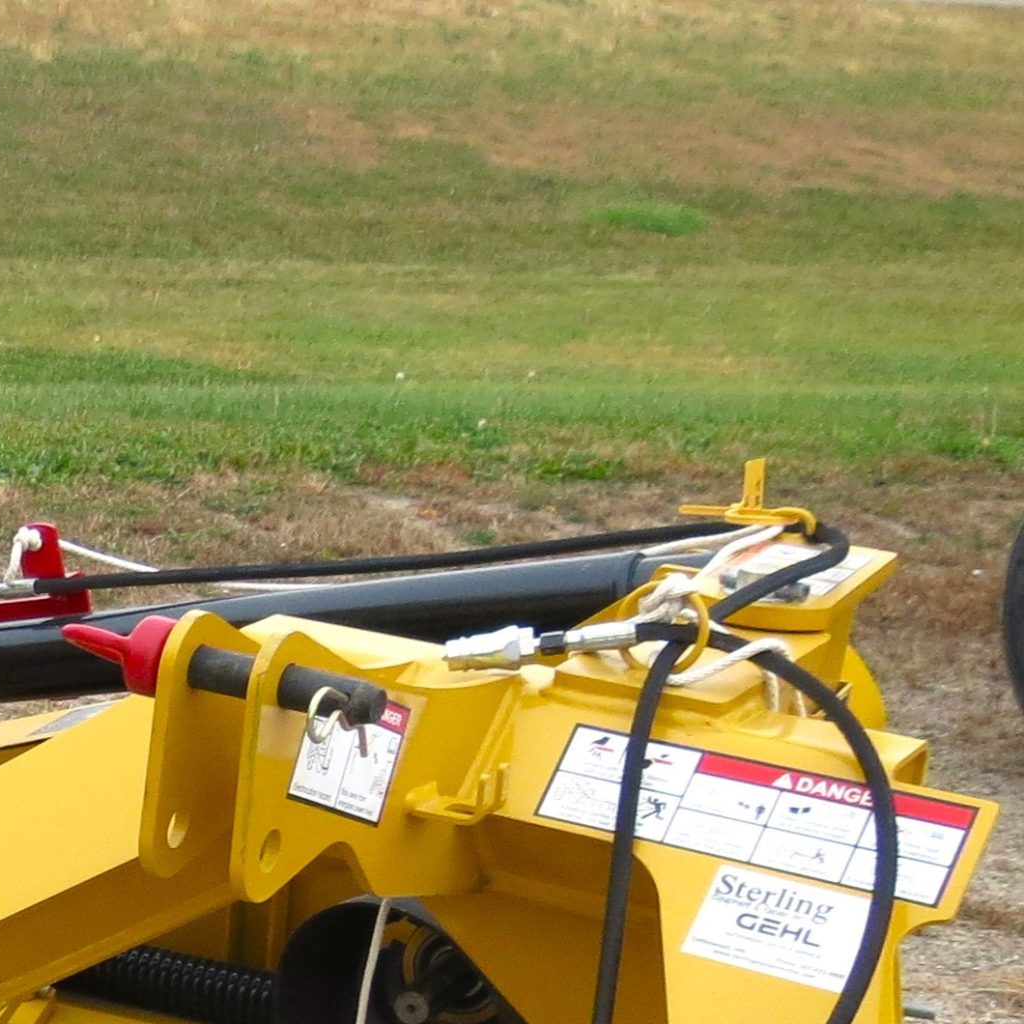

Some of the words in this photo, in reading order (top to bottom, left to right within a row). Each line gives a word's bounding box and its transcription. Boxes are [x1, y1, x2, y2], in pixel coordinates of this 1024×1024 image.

[795, 776, 874, 807] DANGE
[716, 873, 835, 926] Sterling
[736, 912, 821, 948] GEHL
